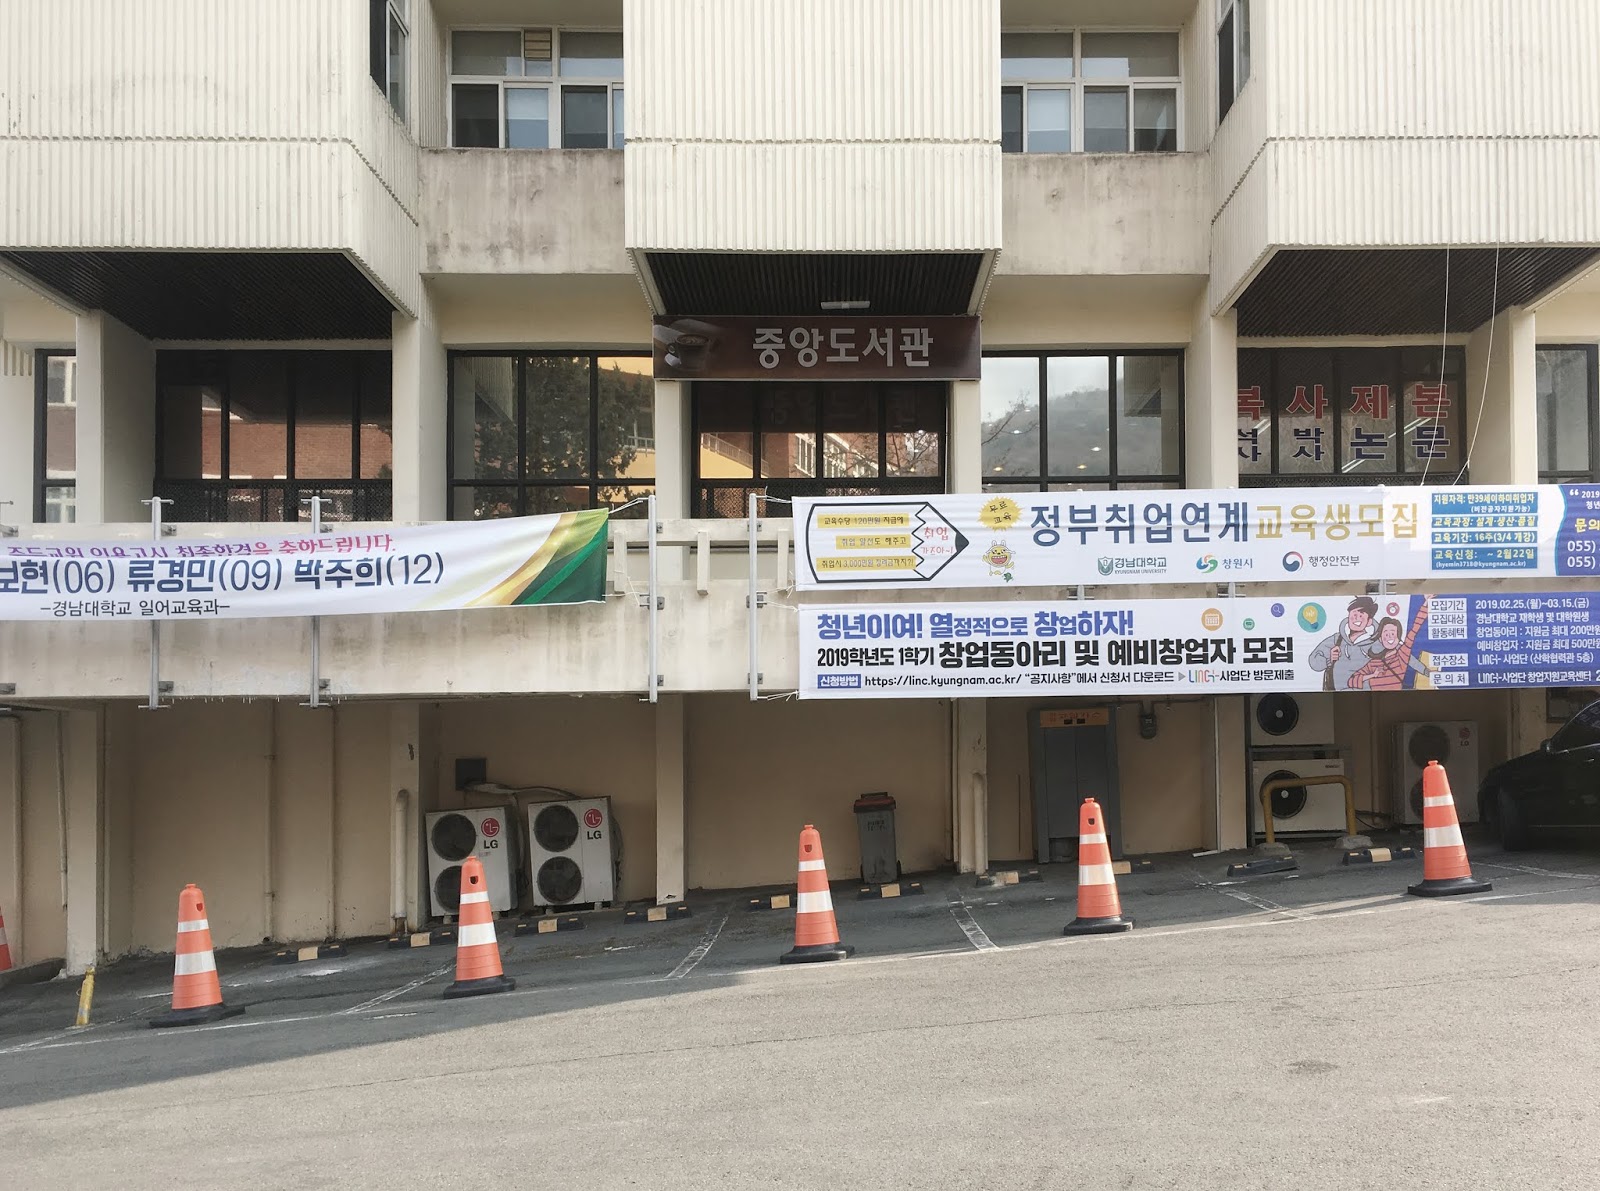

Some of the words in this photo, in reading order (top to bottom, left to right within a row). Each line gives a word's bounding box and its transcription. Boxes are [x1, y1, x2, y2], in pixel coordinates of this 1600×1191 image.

[753, 328, 934, 369] 중앙도서관
[1434, 494, 1466, 505] 지원자격:
[989, 501, 1008, 513] 무료
[994, 512, 1012, 525] 교육
[1434, 517, 1473, 527] 교육과정:
[924, 527, 949, 541] 취업
[1434, 533, 1472, 543] 교육기간:
[1567, 540, 1596, 553] 055)
[1308, 555, 1360, 567] 행정안전부
[1434, 549, 1478, 560] 교육신청:
[1114, 557, 1167, 568] 경남대학교
[1222, 558, 1253, 569] 창원시
[1567, 556, 1596, 569] 055)
[127, 556, 282, 593] 류경민(09)
[295, 551, 445, 591] 박주희(12)
[1431, 600, 1464, 611] 모집기간
[1431, 613, 1464, 624] 모집대상
[1476, 613, 1517, 624] 경남대학교
[1519, 612, 1544, 623] 재학생
[1546, 612, 1554, 623] 및
[1556, 611, 1590, 623] 대학원생
[817, 613, 923, 640] 청년이여!
[929, 612, 1028, 639] 열정적으로
[1034, 610, 1134, 637] 창업하자!
[1431, 627, 1465, 638] 활동혜택
[1476, 626, 1517, 638] 창업동아리
[1525, 626, 1550, 637] 지원금
[1552, 625, 1569, 636] 최대
[1477, 640, 1518, 651] 예비창업자
[1526, 639, 1551, 650] 지원금
[1553, 638, 1570, 649] 최대
[817, 648, 894, 667] 2019학년도
[898, 647, 934, 666] 1학기
[939, 641, 1066, 669] 창업동아리
[1075, 640, 1100, 666] 및
[1107, 637, 1236, 666] 예비창업자
[1243, 637, 1294, 664] 모집
[1432, 655, 1466, 666] 접수장소
[1503, 653, 1528, 664] 사업단
[820, 676, 859, 687] 신청방법
[865, 674, 1022, 688] https://linc.kyungnam.ac.kr/
[1100, 671, 1131, 683] 신청서
[1133, 671, 1174, 683] 다운로드
[1253, 669, 1295, 681] 방문제출
[1527, 670, 1592, 683] 창업지원교육센터
[586, 830, 602, 840] LG
[483, 840, 499, 849] LG
